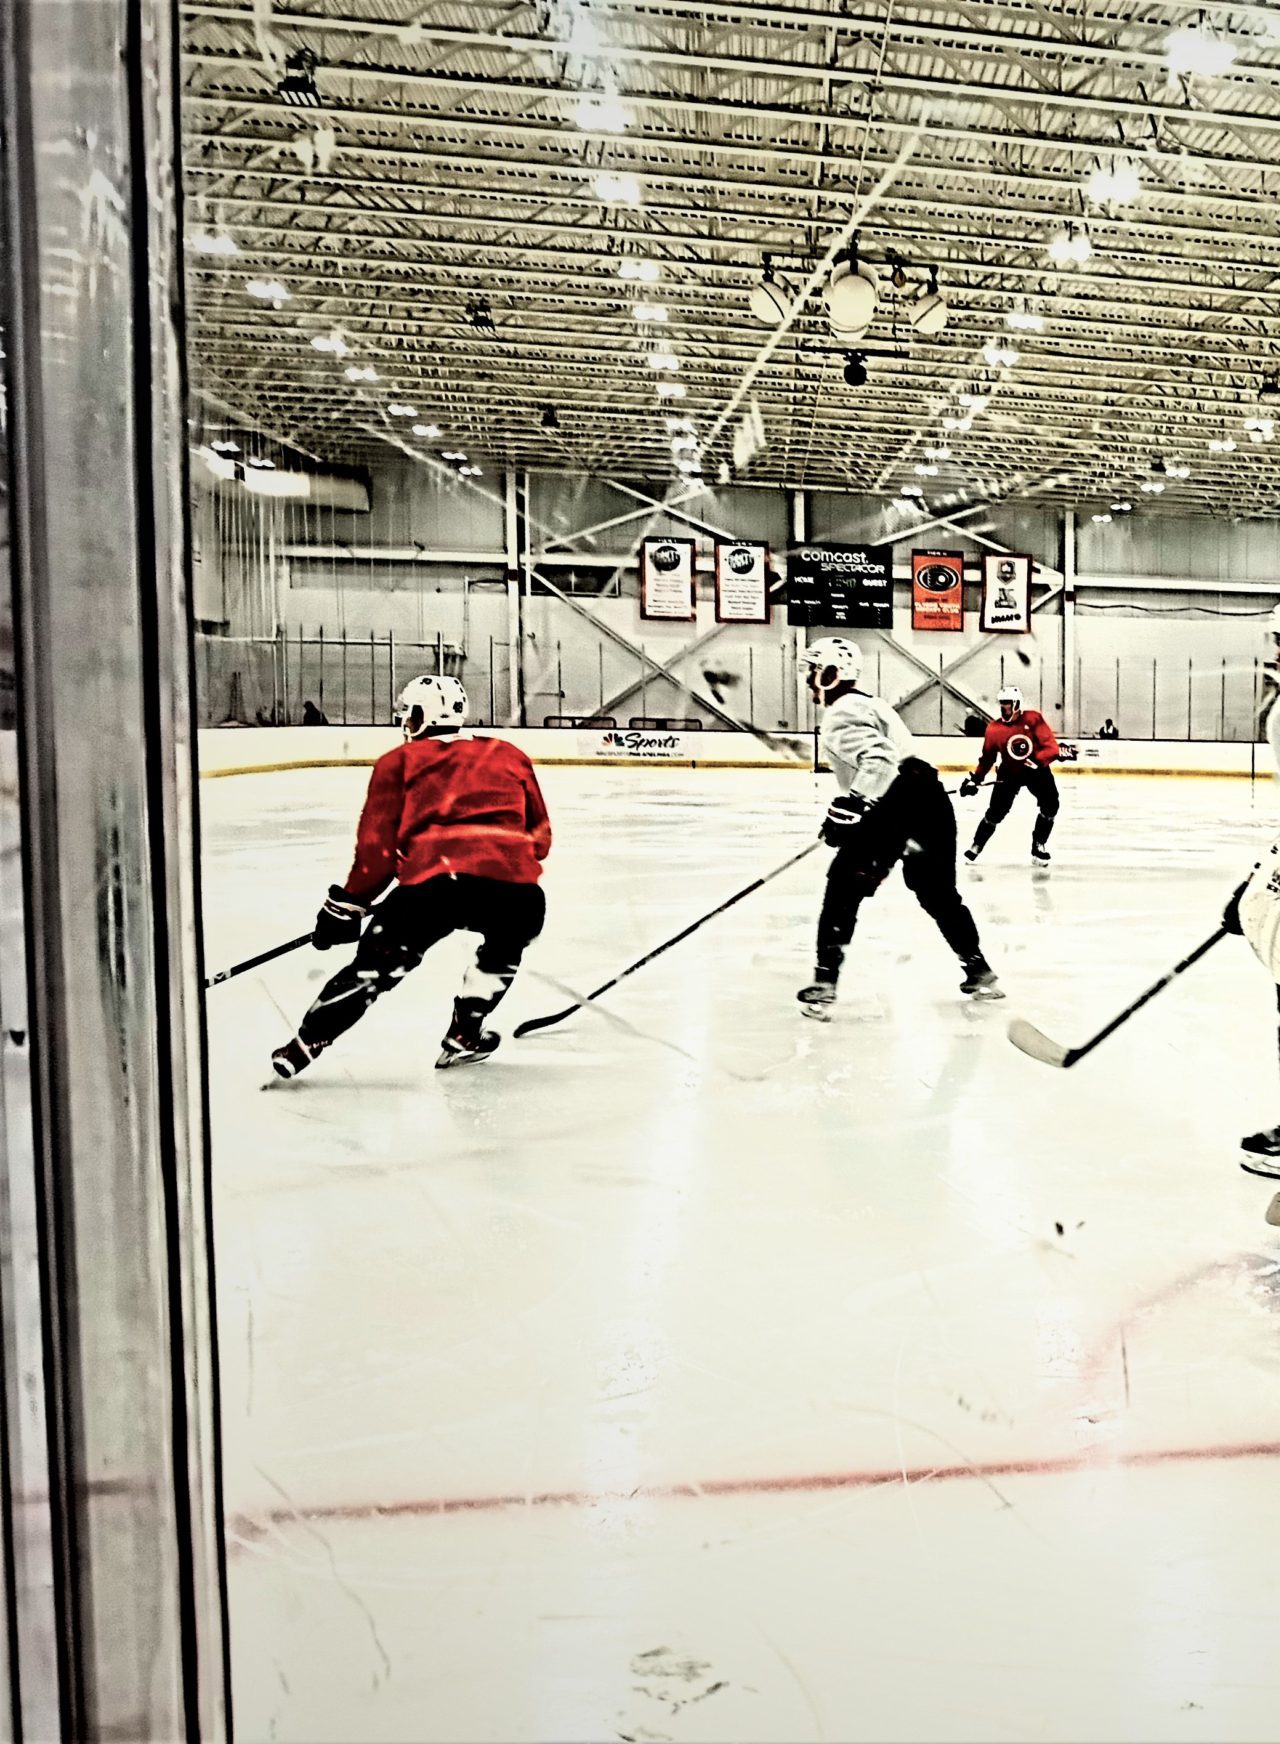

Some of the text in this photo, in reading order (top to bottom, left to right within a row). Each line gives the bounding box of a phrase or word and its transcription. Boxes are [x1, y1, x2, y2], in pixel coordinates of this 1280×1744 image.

[821, 562, 885, 574] SPECTACOR
[862, 578, 887, 587] GUEST
[625, 733, 680, 751] Sports
